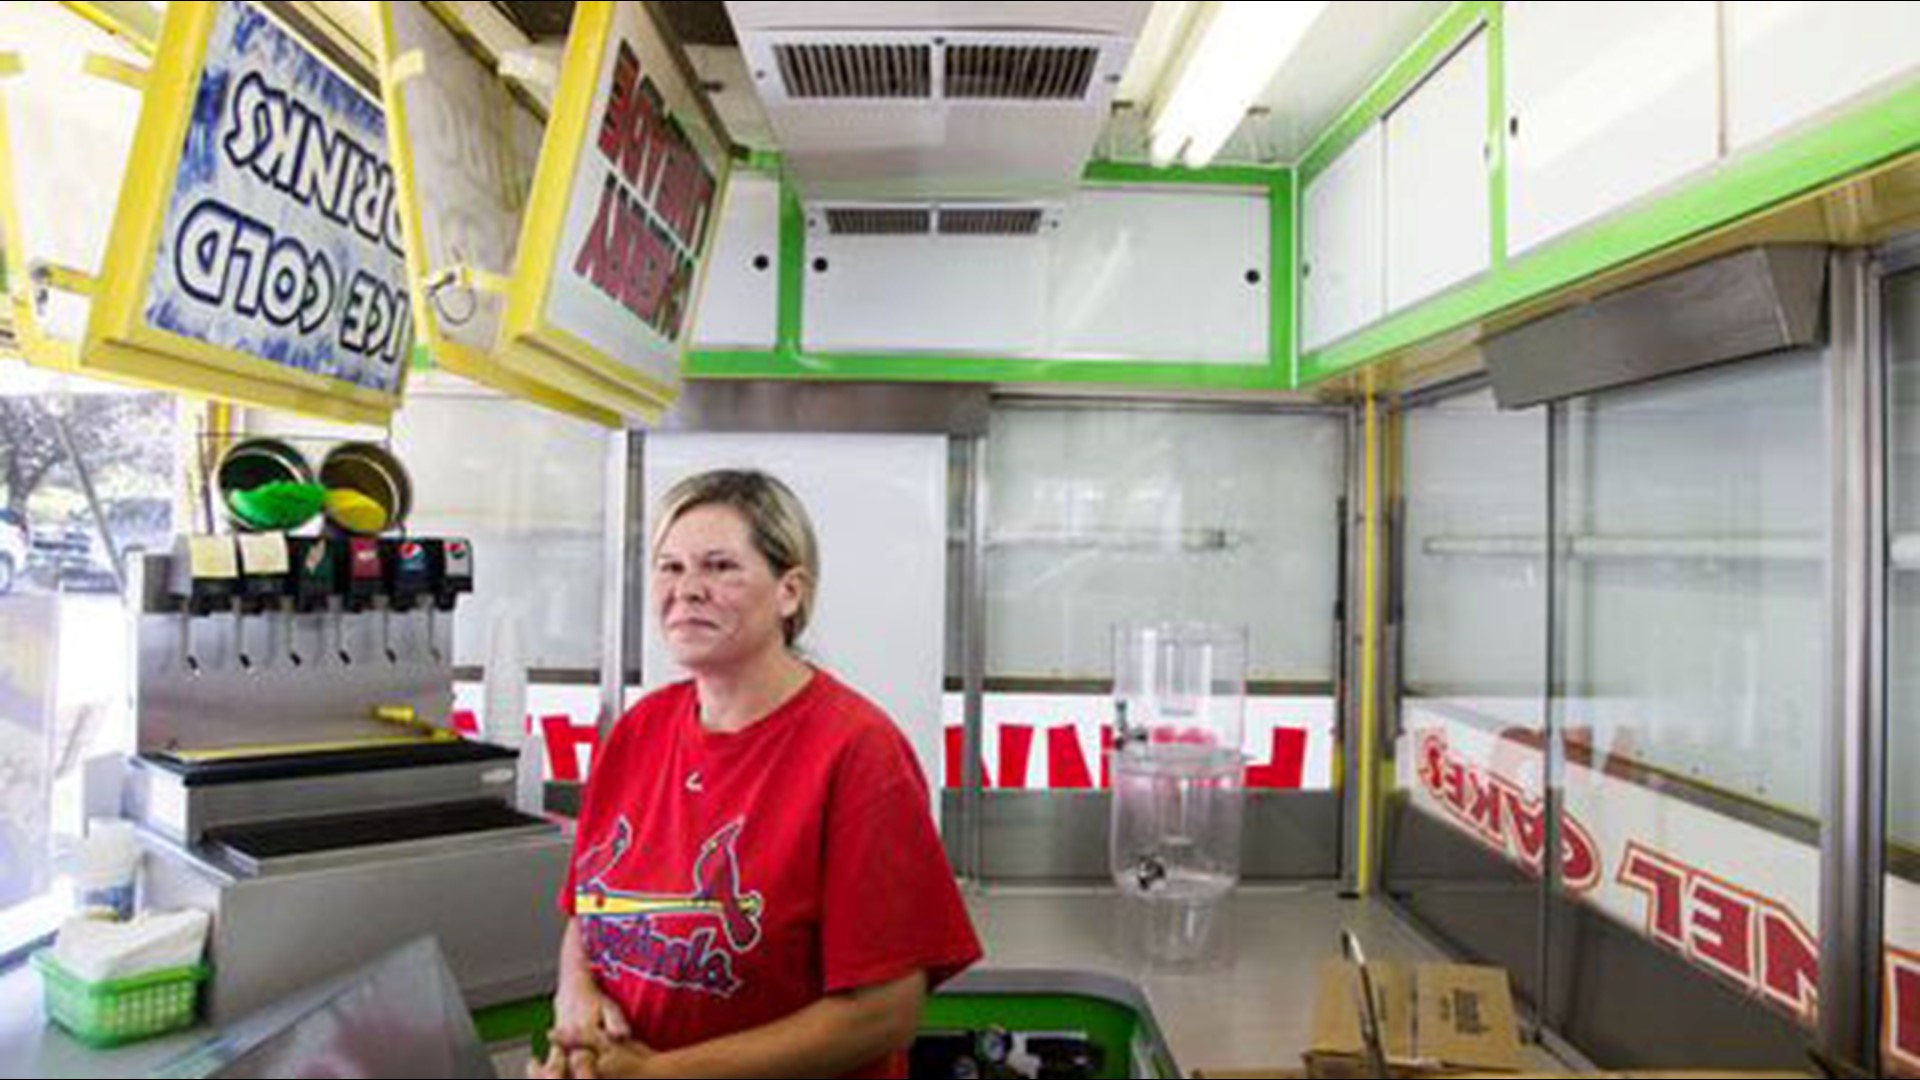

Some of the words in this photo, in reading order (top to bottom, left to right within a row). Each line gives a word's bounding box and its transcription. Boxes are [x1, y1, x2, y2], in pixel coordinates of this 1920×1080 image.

[175, 199, 335, 334] COLD
[340, 270, 407, 363] ICE
[1416, 735, 1602, 890] CAKES
[1616, 840, 1822, 1030] NEL
